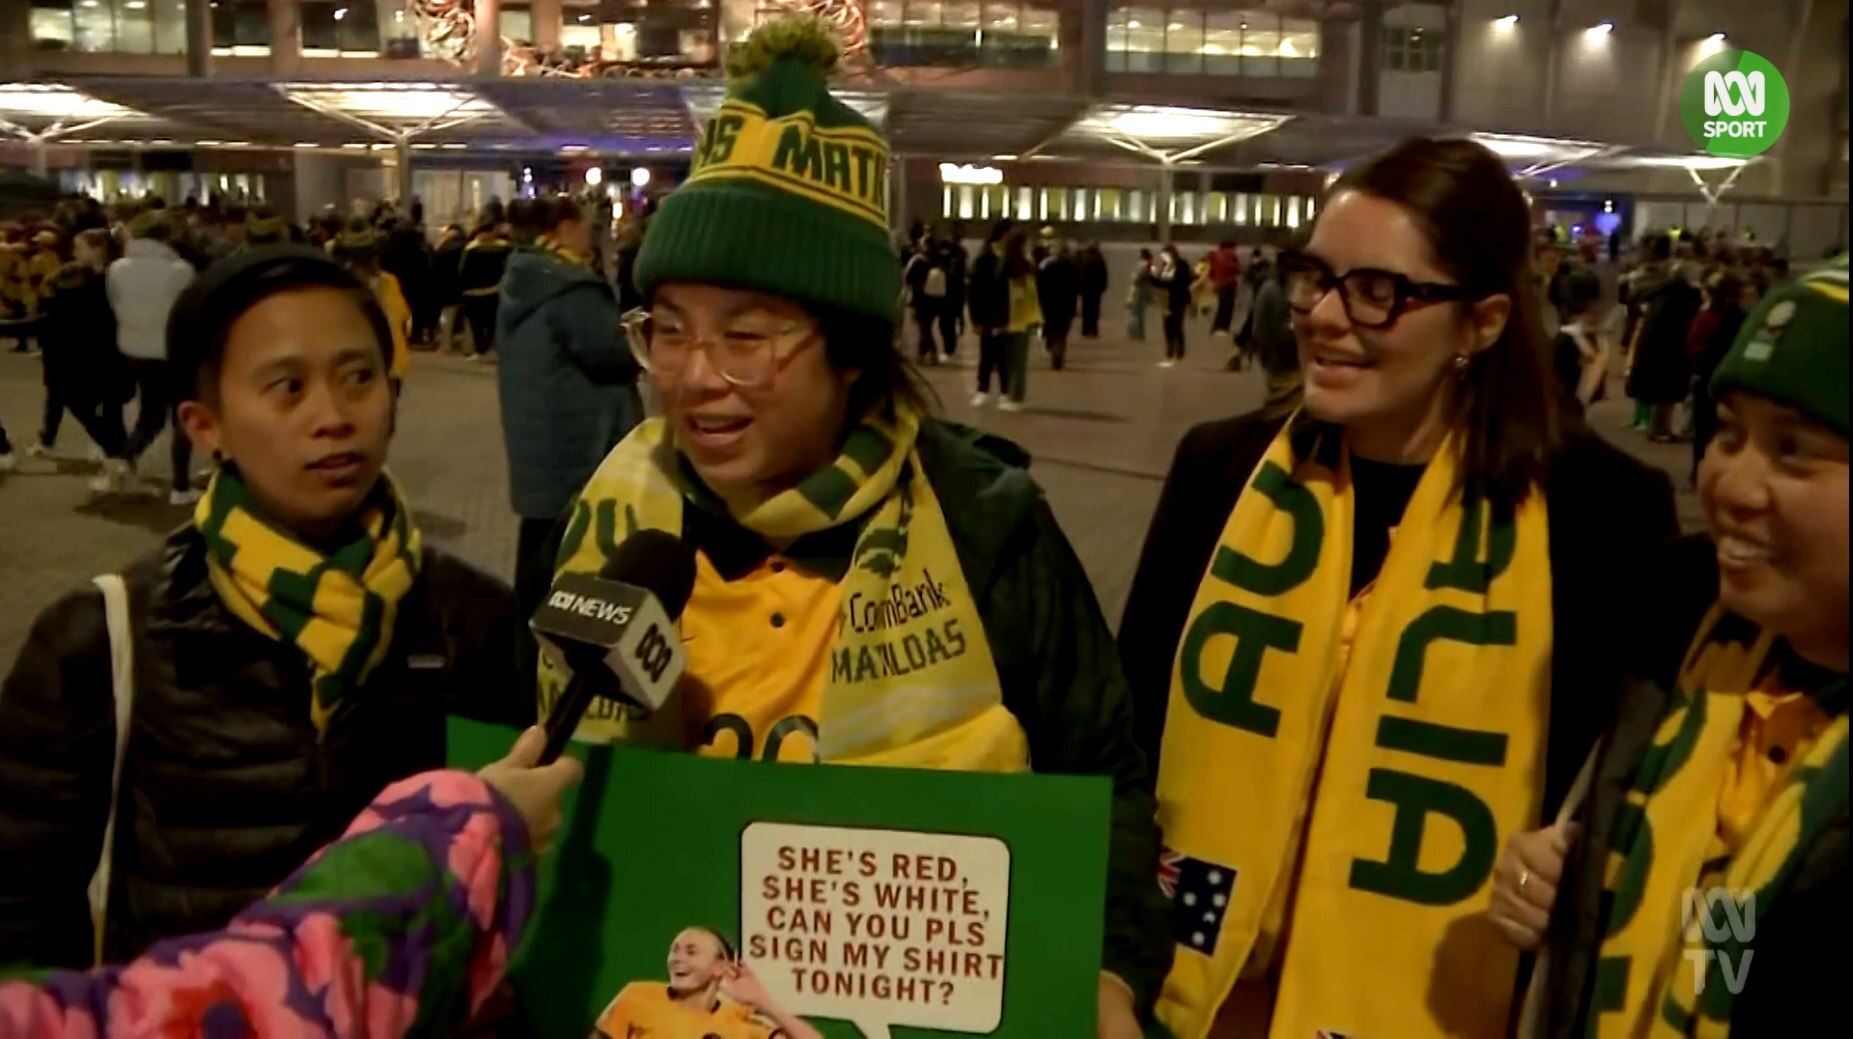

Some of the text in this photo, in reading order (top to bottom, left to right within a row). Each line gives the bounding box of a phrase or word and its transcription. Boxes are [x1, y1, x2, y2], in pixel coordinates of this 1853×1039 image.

[570, 594, 632, 625] NEWS
[778, 846, 968, 888] SHE'S RED,
[762, 875, 989, 921] SHE'S WHITE,
[767, 905, 985, 946] CAN YOU PLS
[750, 934, 1003, 980] SIGN MY SHIRT
[791, 968, 955, 1006] TONIGHT?
